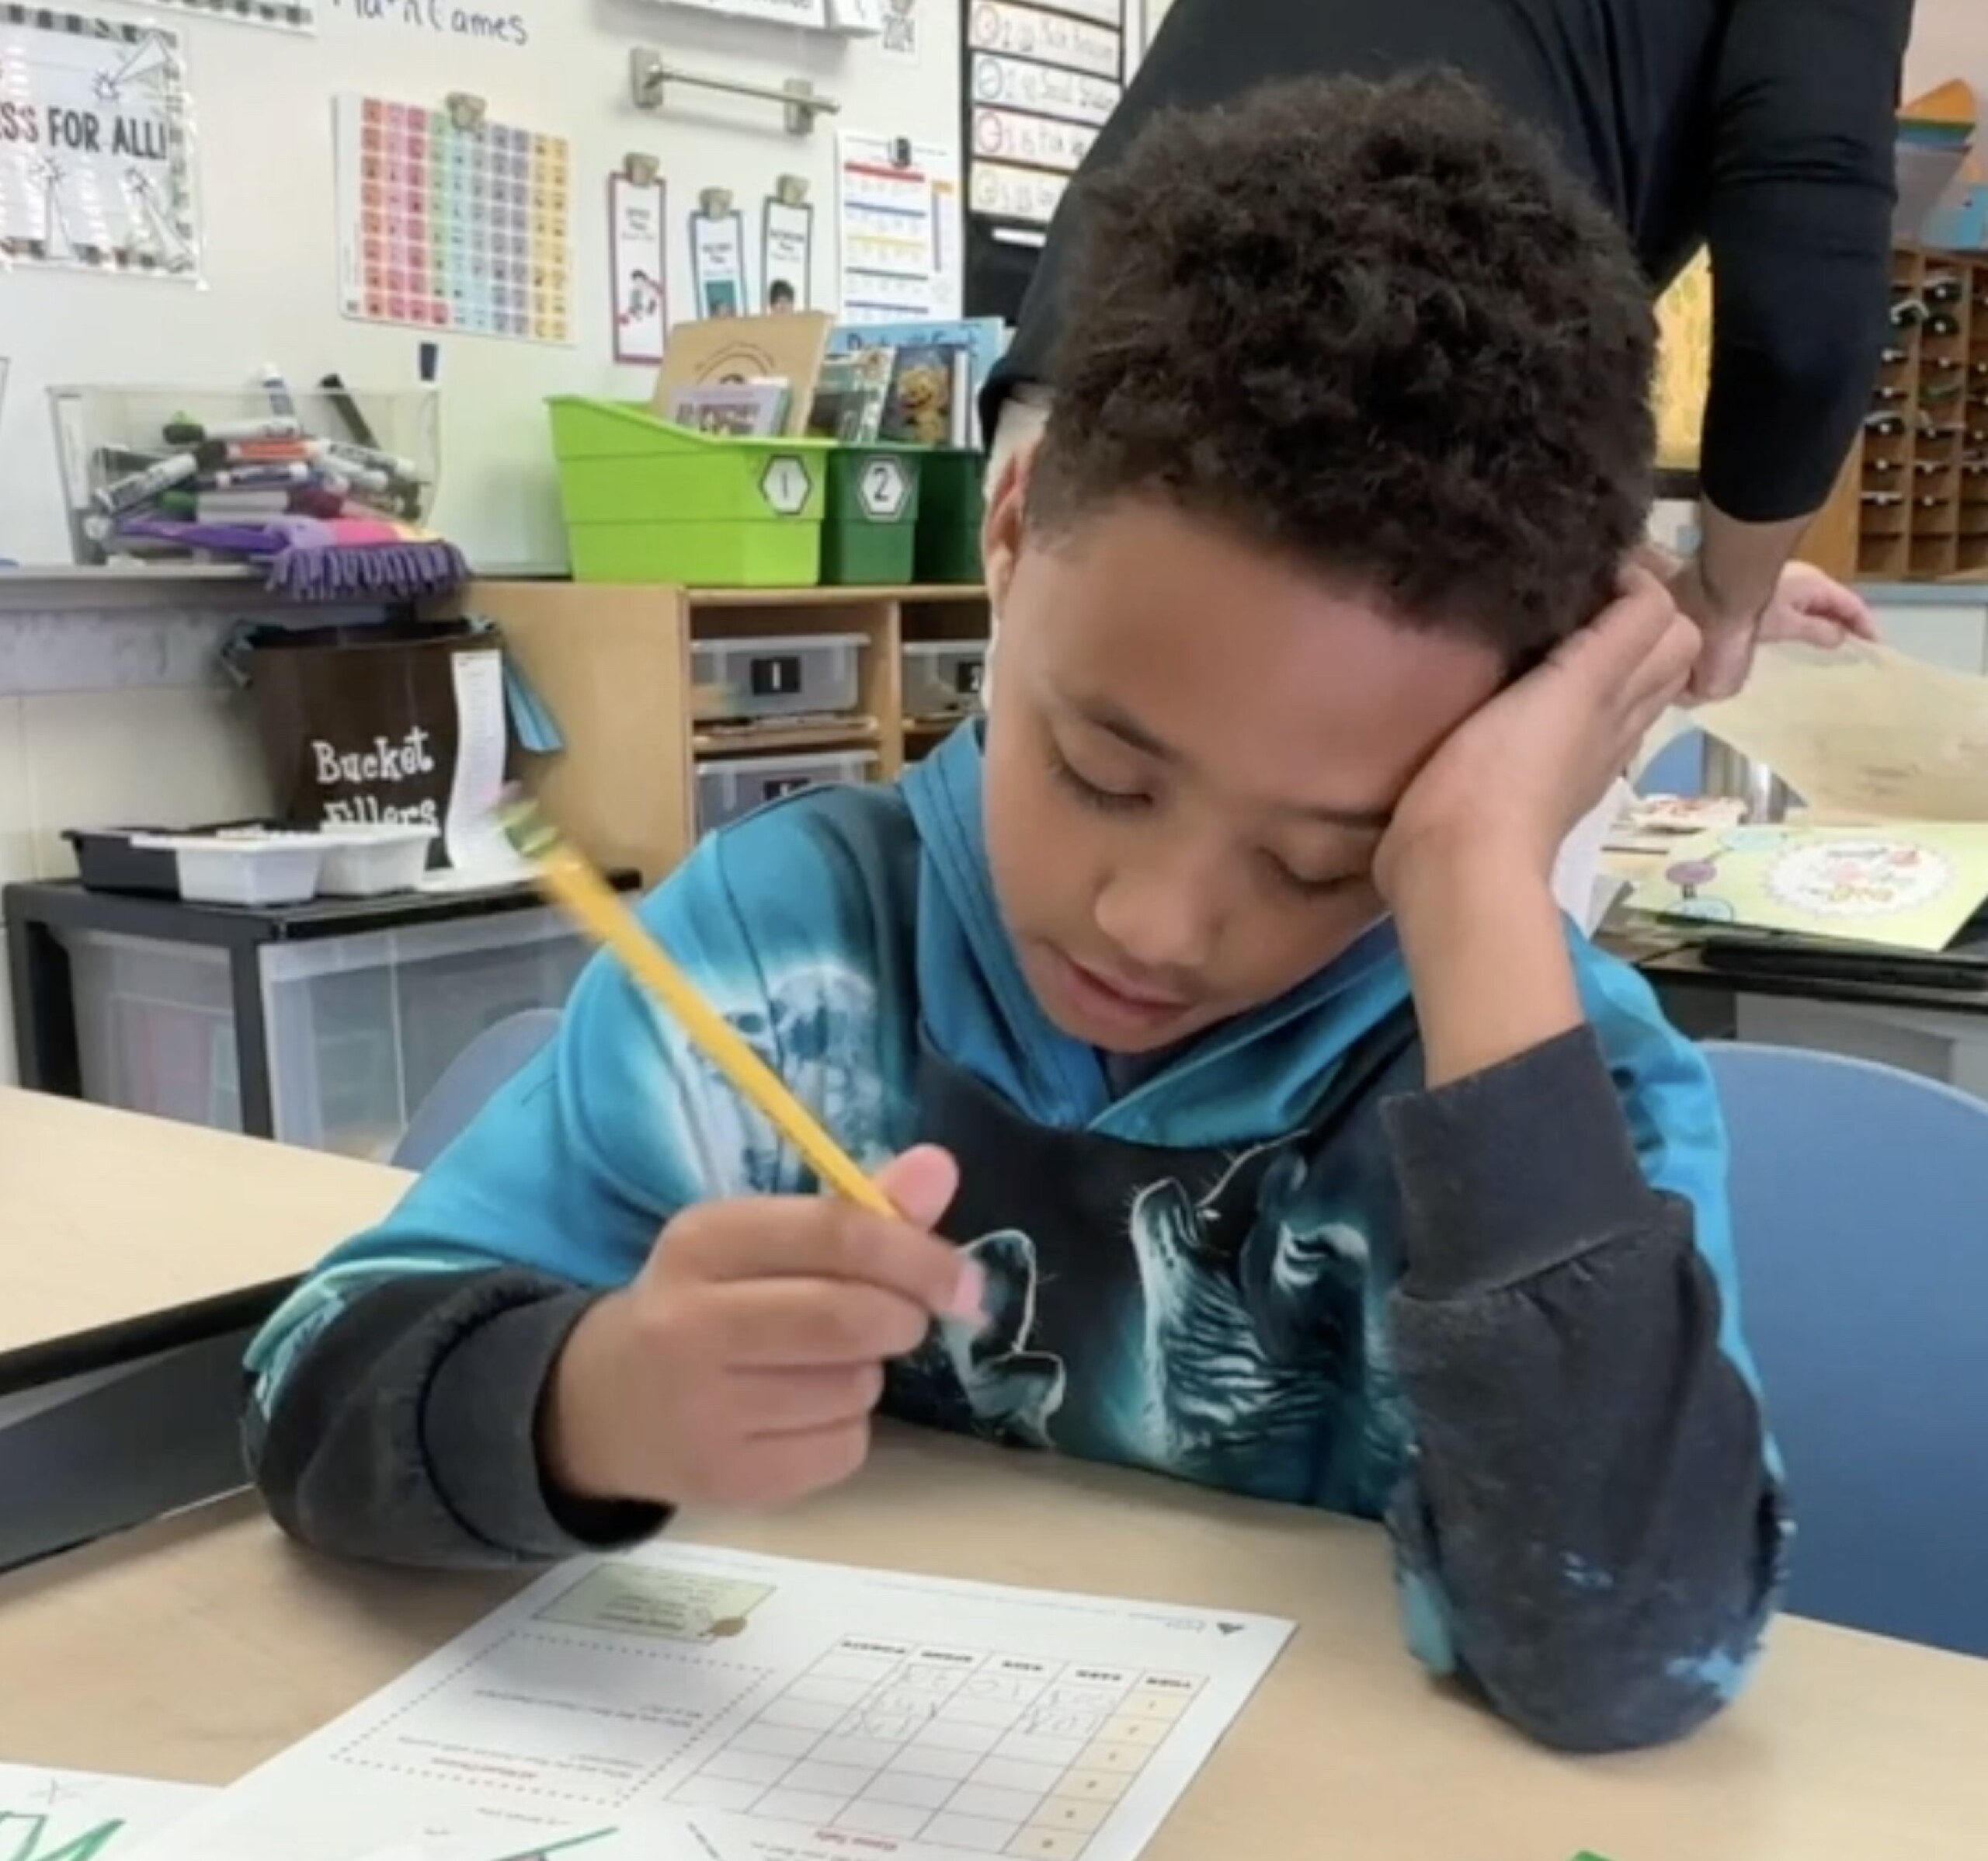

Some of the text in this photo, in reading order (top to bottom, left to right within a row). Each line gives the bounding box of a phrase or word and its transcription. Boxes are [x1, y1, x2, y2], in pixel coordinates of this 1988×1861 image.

[0, 102, 39, 143] SS
[48, 106, 99, 153] FOR
[781, 470, 789, 499] 1
[874, 467, 889, 502] 2
[311, 725, 435, 784] Bucket
